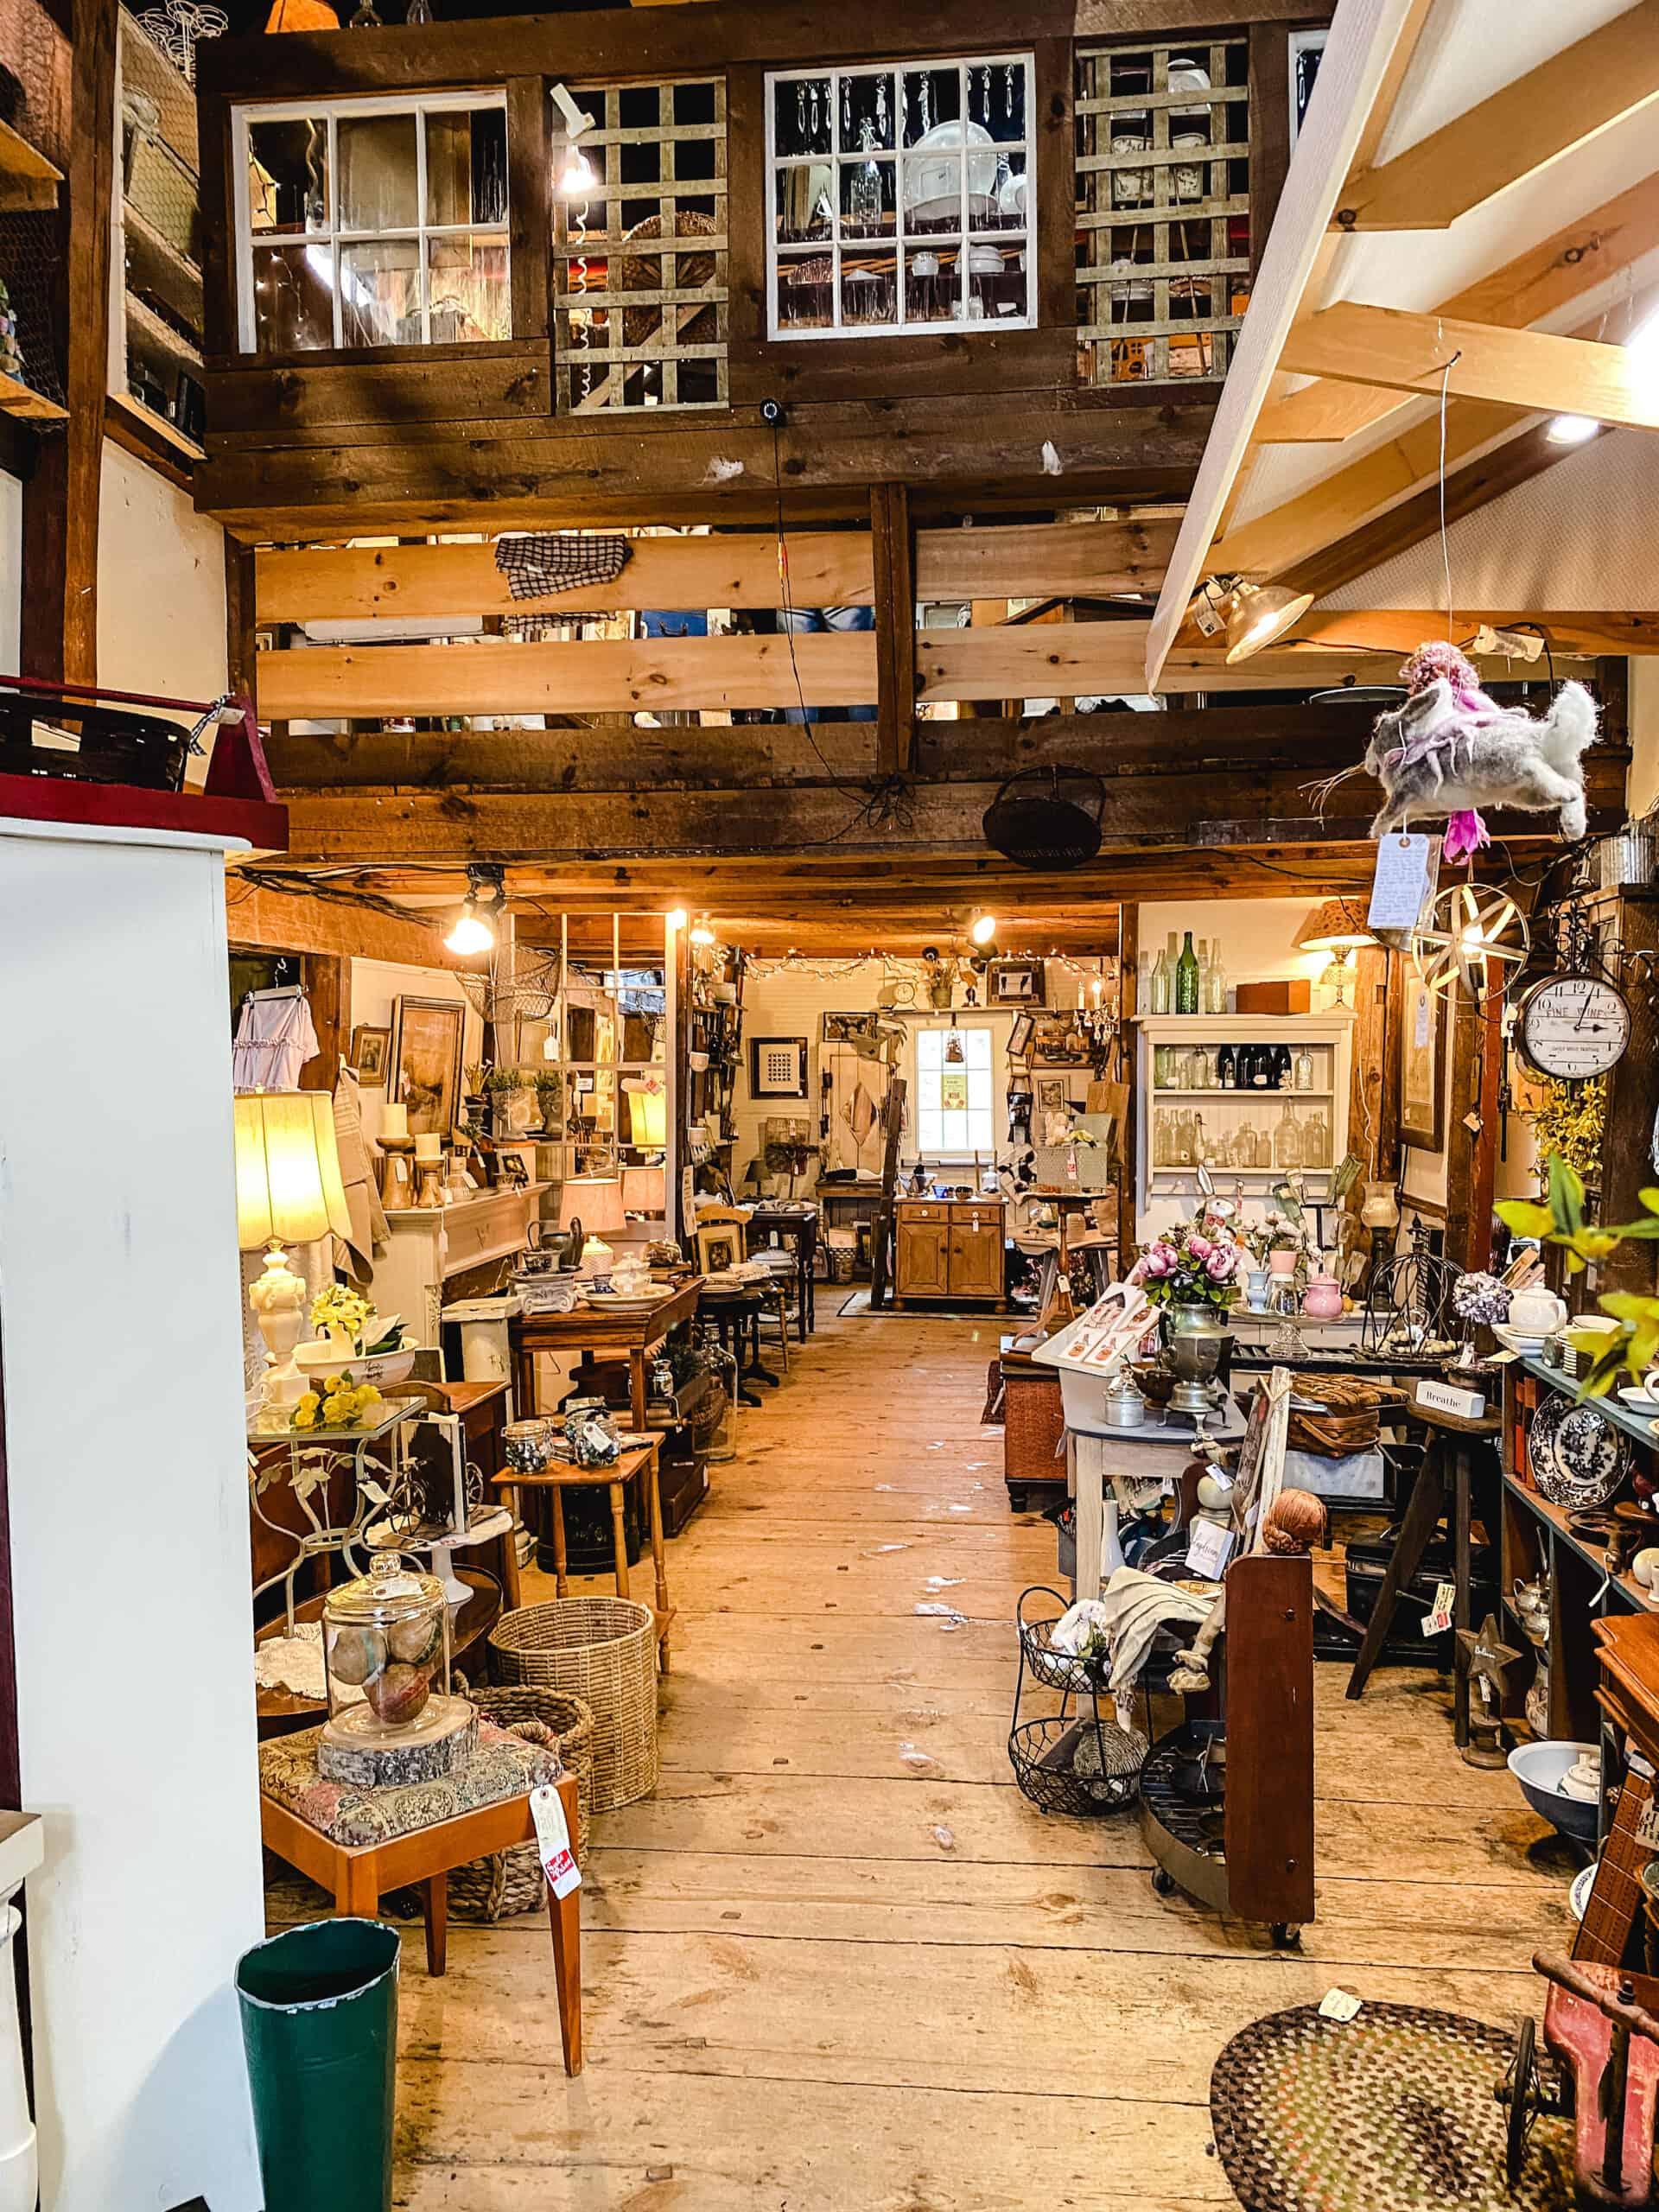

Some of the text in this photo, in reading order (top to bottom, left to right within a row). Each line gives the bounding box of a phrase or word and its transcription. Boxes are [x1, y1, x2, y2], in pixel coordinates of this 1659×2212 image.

[1554, 985, 1563, 997] 11
[1573, 982, 1586, 995] 12
[1537, 998, 1552, 1010] 10
[1546, 1007, 1569, 1017] FINE
[1425, 1389, 1461, 1408] Breathe
